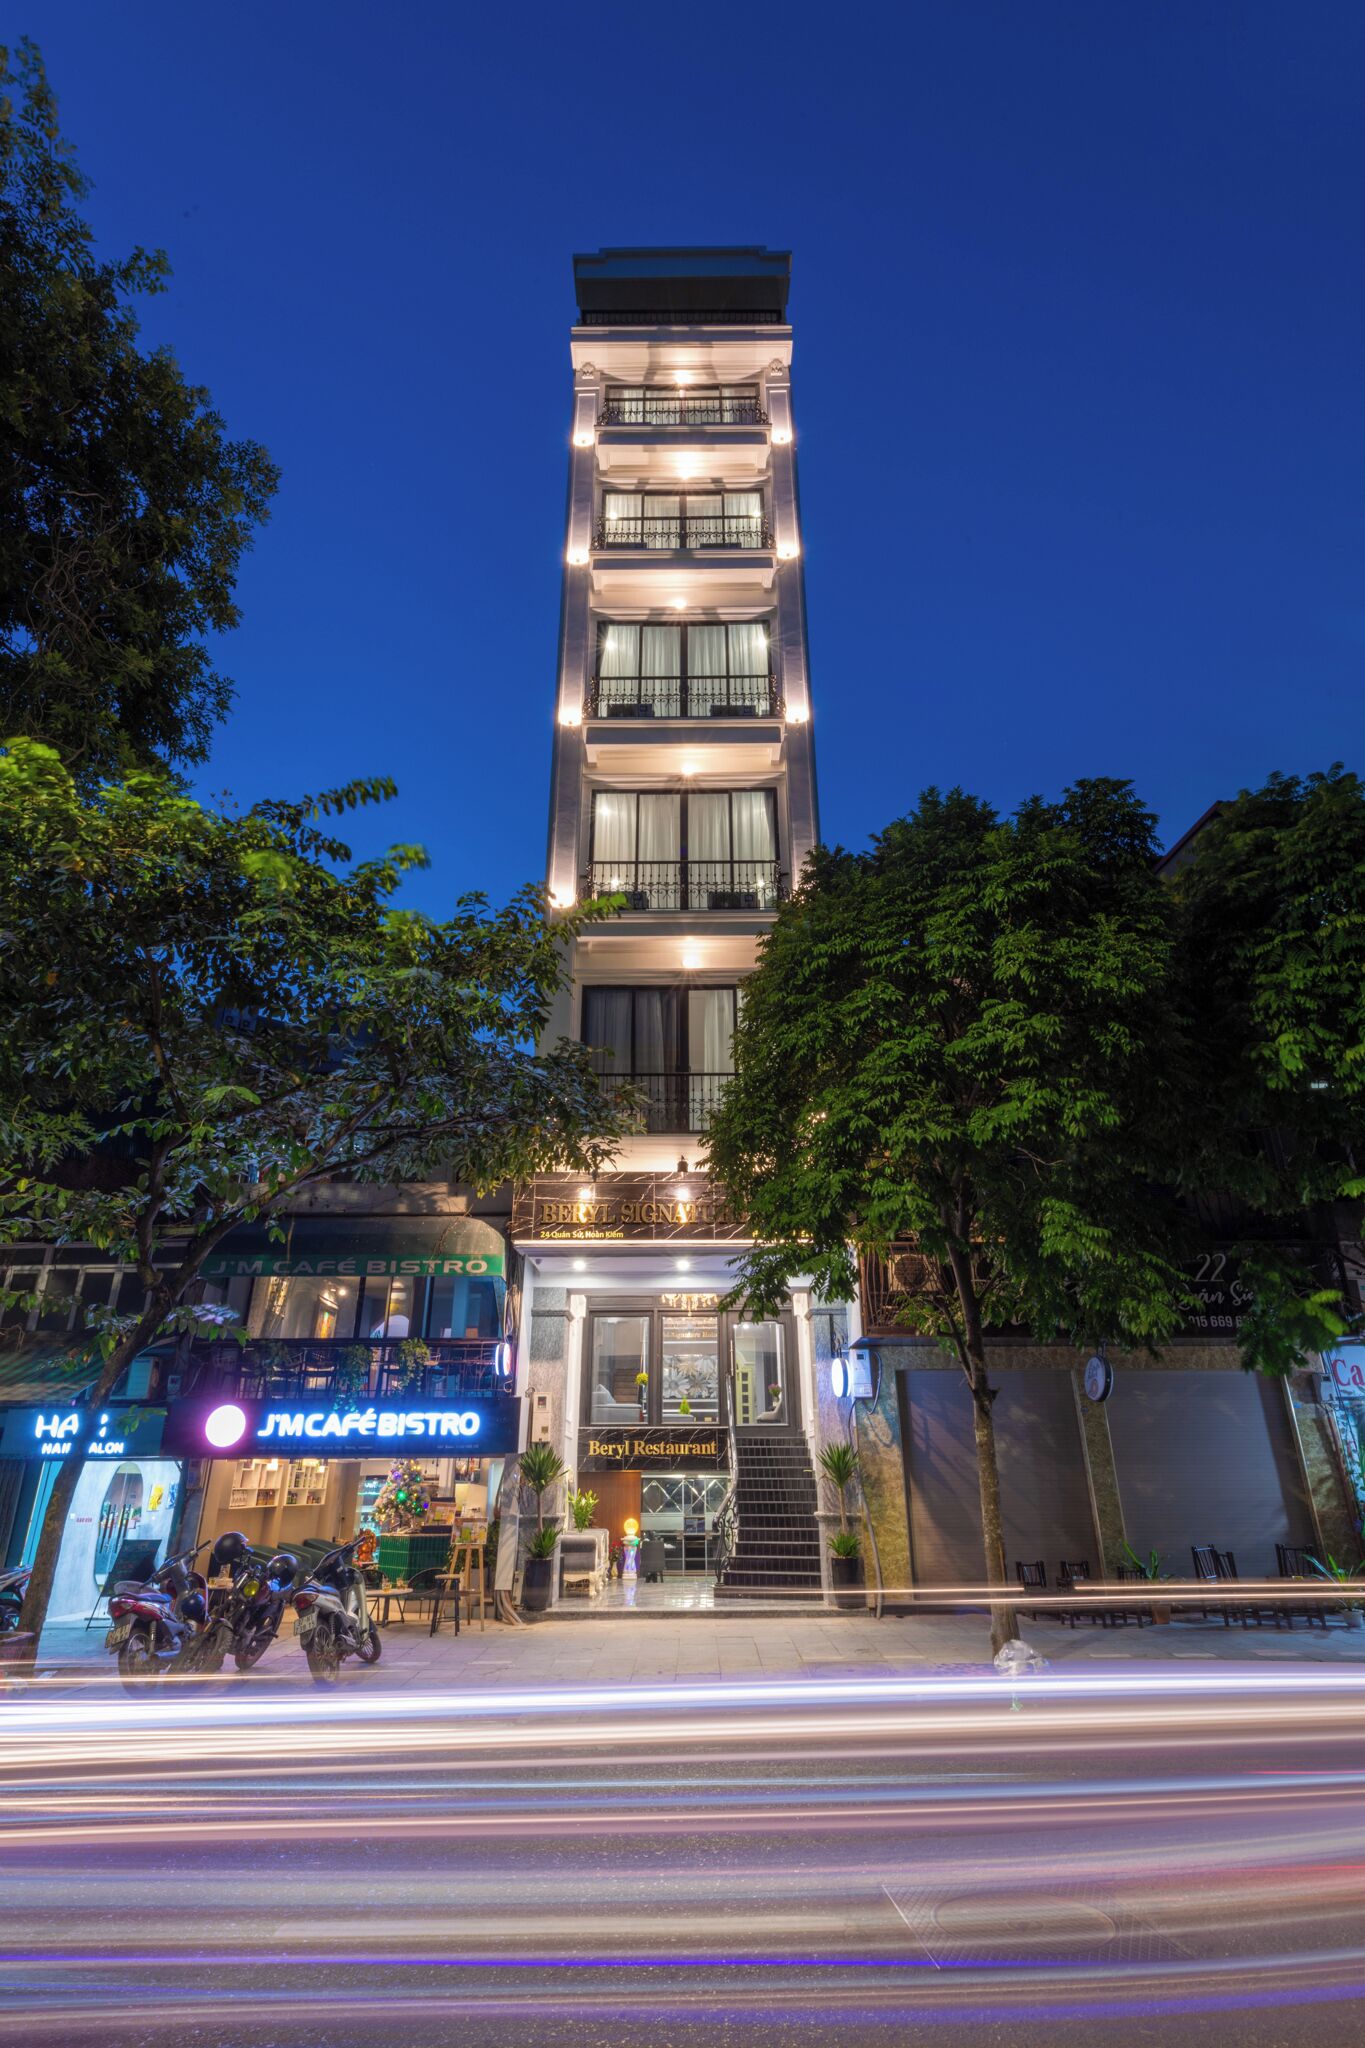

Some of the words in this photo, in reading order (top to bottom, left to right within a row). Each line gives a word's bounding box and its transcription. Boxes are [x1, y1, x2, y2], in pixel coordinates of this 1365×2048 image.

[541, 1203, 616, 1224] BERYL
[272, 1257, 358, 1274] CAFÉ
[366, 1260, 488, 1274] BISTRO
[1194, 1253, 1226, 1282] 22
[1210, 1315, 1233, 1328] 669
[377, 1412, 481, 1437] BISTRO
[88, 1442, 125, 1455] ALON
[588, 1439, 630, 1459] Beryl
[633, 1439, 718, 1456] Restaurant
